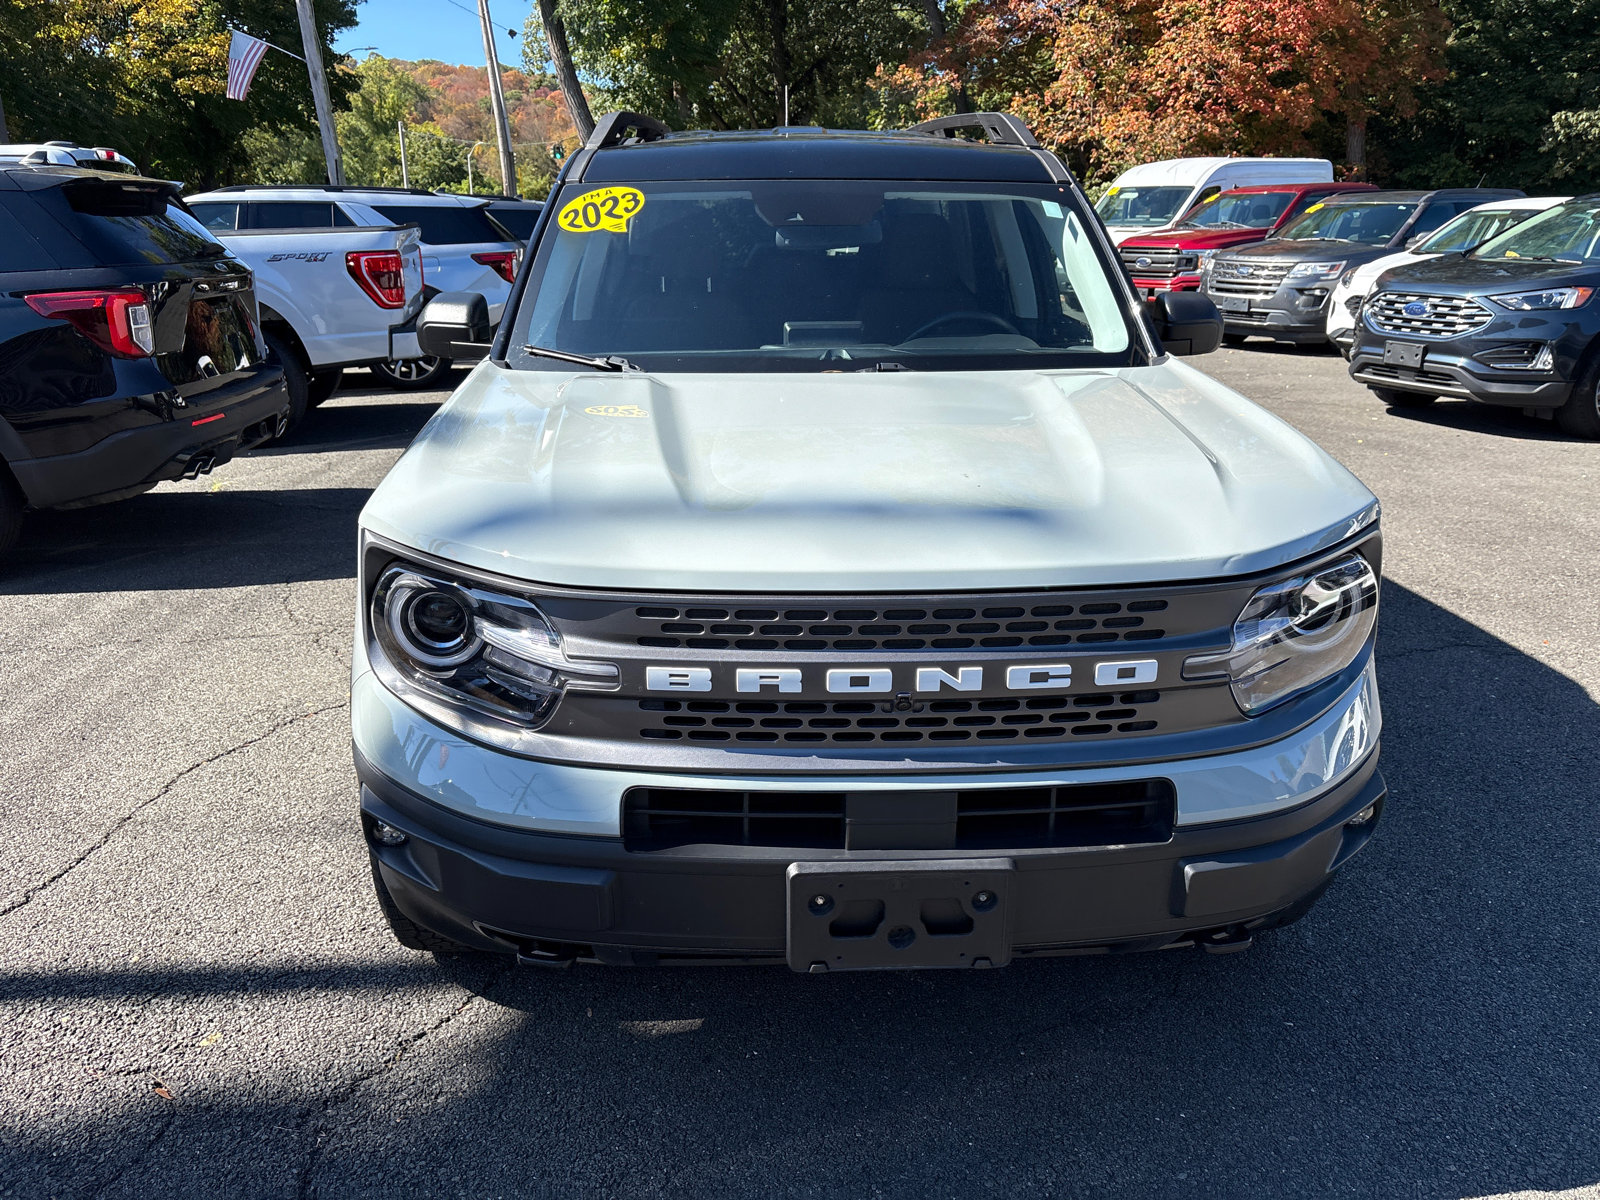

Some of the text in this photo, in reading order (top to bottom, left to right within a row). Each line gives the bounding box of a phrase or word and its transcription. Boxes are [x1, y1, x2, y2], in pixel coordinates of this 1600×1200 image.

[582, 192, 600, 201] I'M
[563, 192, 640, 228] 2023
[266, 251, 333, 262] SPORT
[645, 659, 1159, 693] BRONCO
